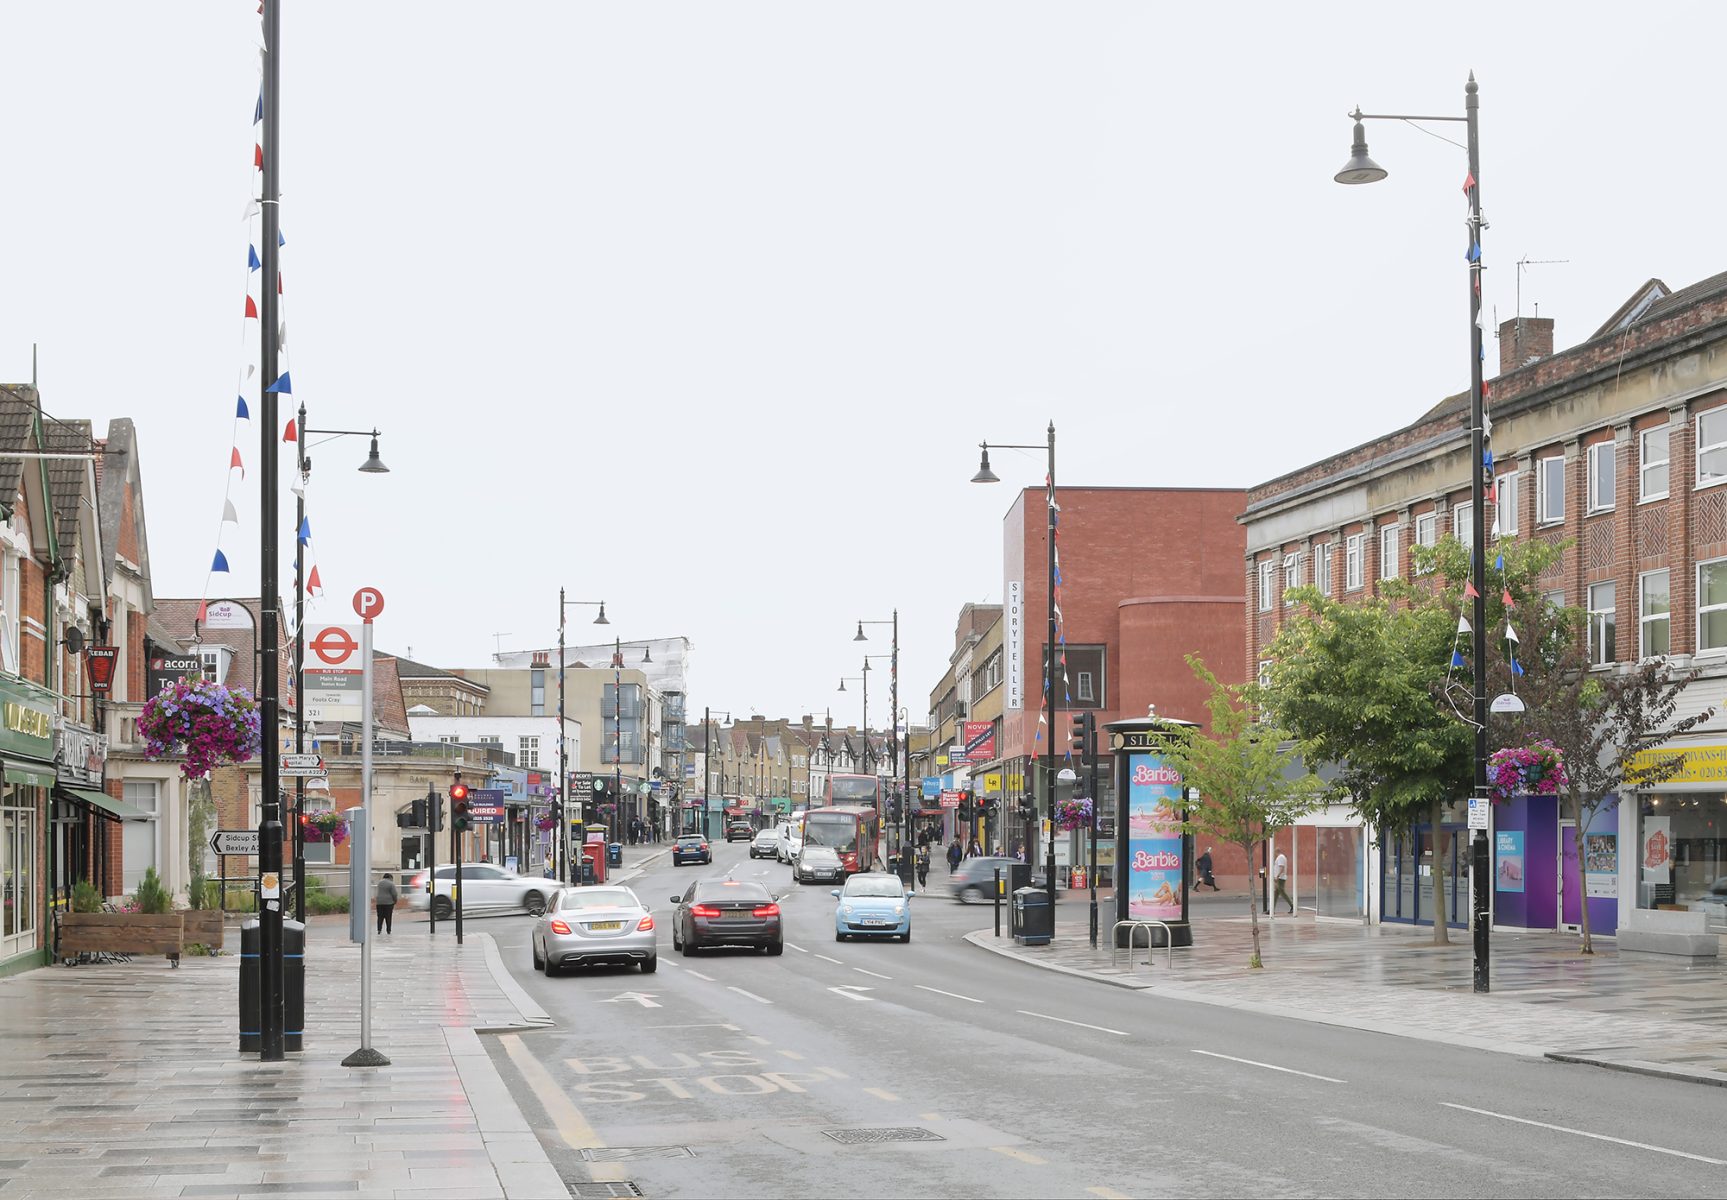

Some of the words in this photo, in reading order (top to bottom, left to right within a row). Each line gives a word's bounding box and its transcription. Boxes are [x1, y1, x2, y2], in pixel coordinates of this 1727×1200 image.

[361, 592, 376, 614] P
[164, 660, 198, 669] acorn
[158, 678, 175, 689] To
[1130, 736, 1180, 746] SIDU
[1132, 764, 1179, 783] Barbie
[225, 834, 250, 842] Sidcup
[225, 844, 249, 852] Bexley
[1132, 850, 1179, 869] Barbie
[564, 1050, 770, 1075] BUS
[573, 1071, 830, 1102] STOP
